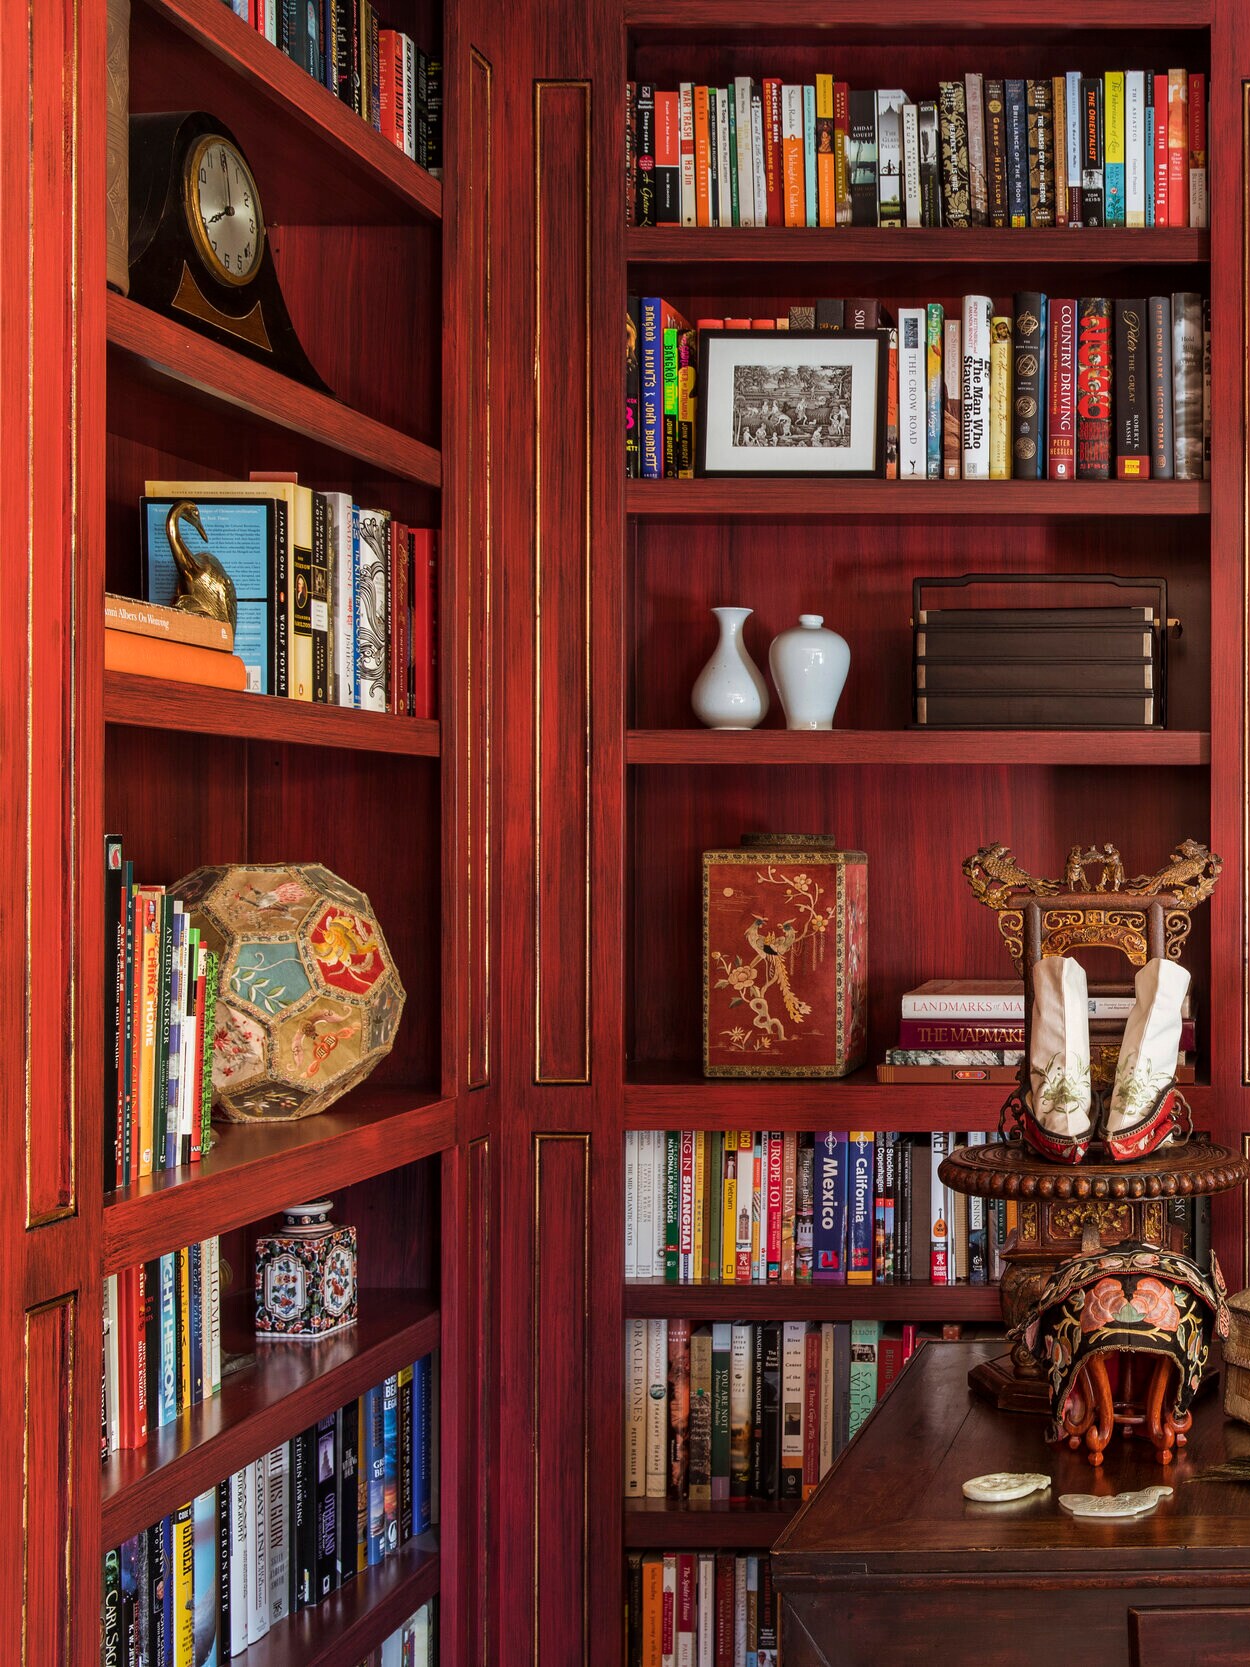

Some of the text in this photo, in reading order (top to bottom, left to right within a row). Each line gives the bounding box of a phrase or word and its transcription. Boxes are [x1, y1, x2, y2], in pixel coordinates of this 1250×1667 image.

[683, 90, 692, 137] WAR TRASH
[1014, 152, 1020, 161] OF
[1158, 164, 1167, 204] Waiting
[1122, 311, 1139, 353] Peter
[1061, 306, 1071, 430] COUNTRY DRIVING
[963, 356, 972, 450] Stayed Behind
[973, 358, 982, 449] The Man Who
[645, 402, 657, 471] JOHN BURDETT
[119, 610, 137, 621] Albers
[138, 613, 147, 622] On
[146, 1001, 154, 1046] HOME
[913, 1001, 992, 1012] LANDMARKS
[918, 1028, 1024, 1043] THE MAPMAKE
[855, 1158, 867, 1222] California
[876, 1148, 884, 1192] Copenhagen
[823, 1158, 838, 1229] Mexico
[164, 1319, 173, 1408] HERON
[634, 1320, 643, 1422] ORACLE BONES
[270, 1504, 284, 1549] GLORY
